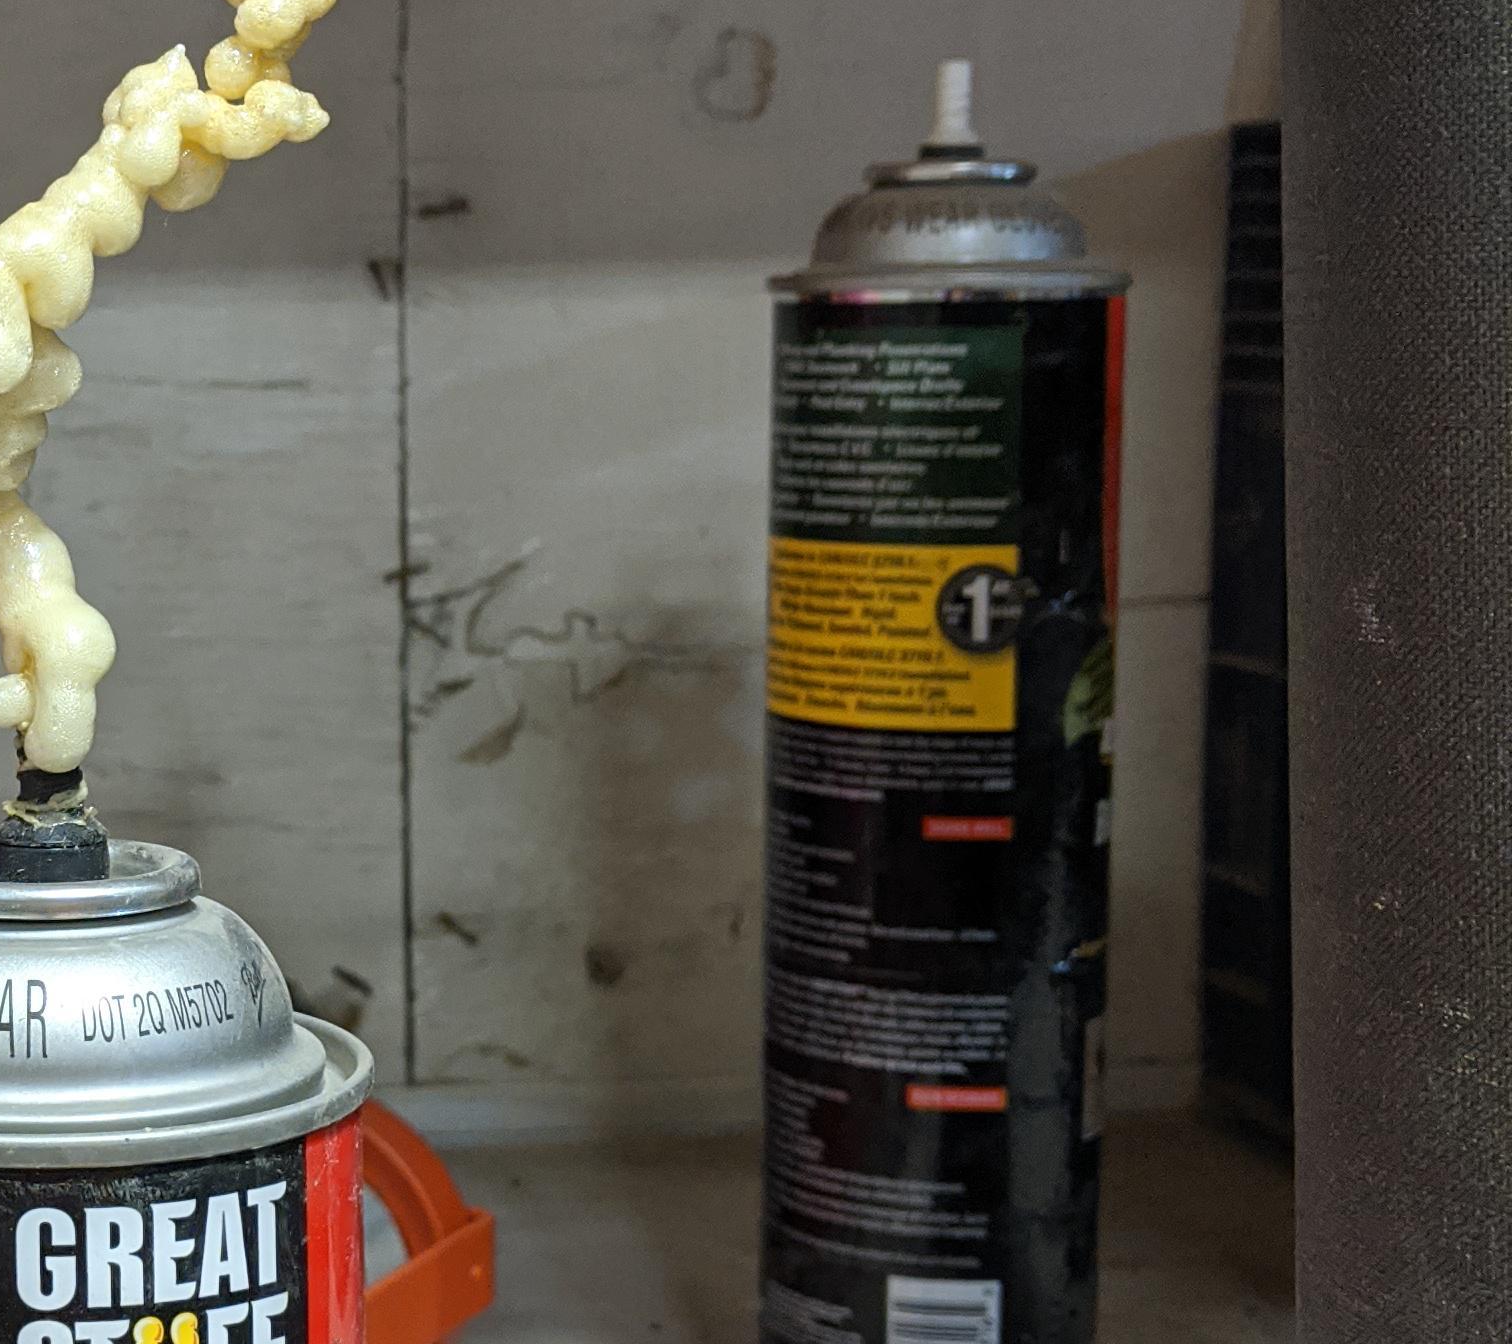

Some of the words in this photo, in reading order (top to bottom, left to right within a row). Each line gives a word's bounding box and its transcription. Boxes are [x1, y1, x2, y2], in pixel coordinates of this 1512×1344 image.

[82, 994, 126, 1043] DOT
[133, 991, 168, 1037] 2Q
[165, 979, 234, 1031] M5702
[16, 1180, 287, 1312] GREAT
